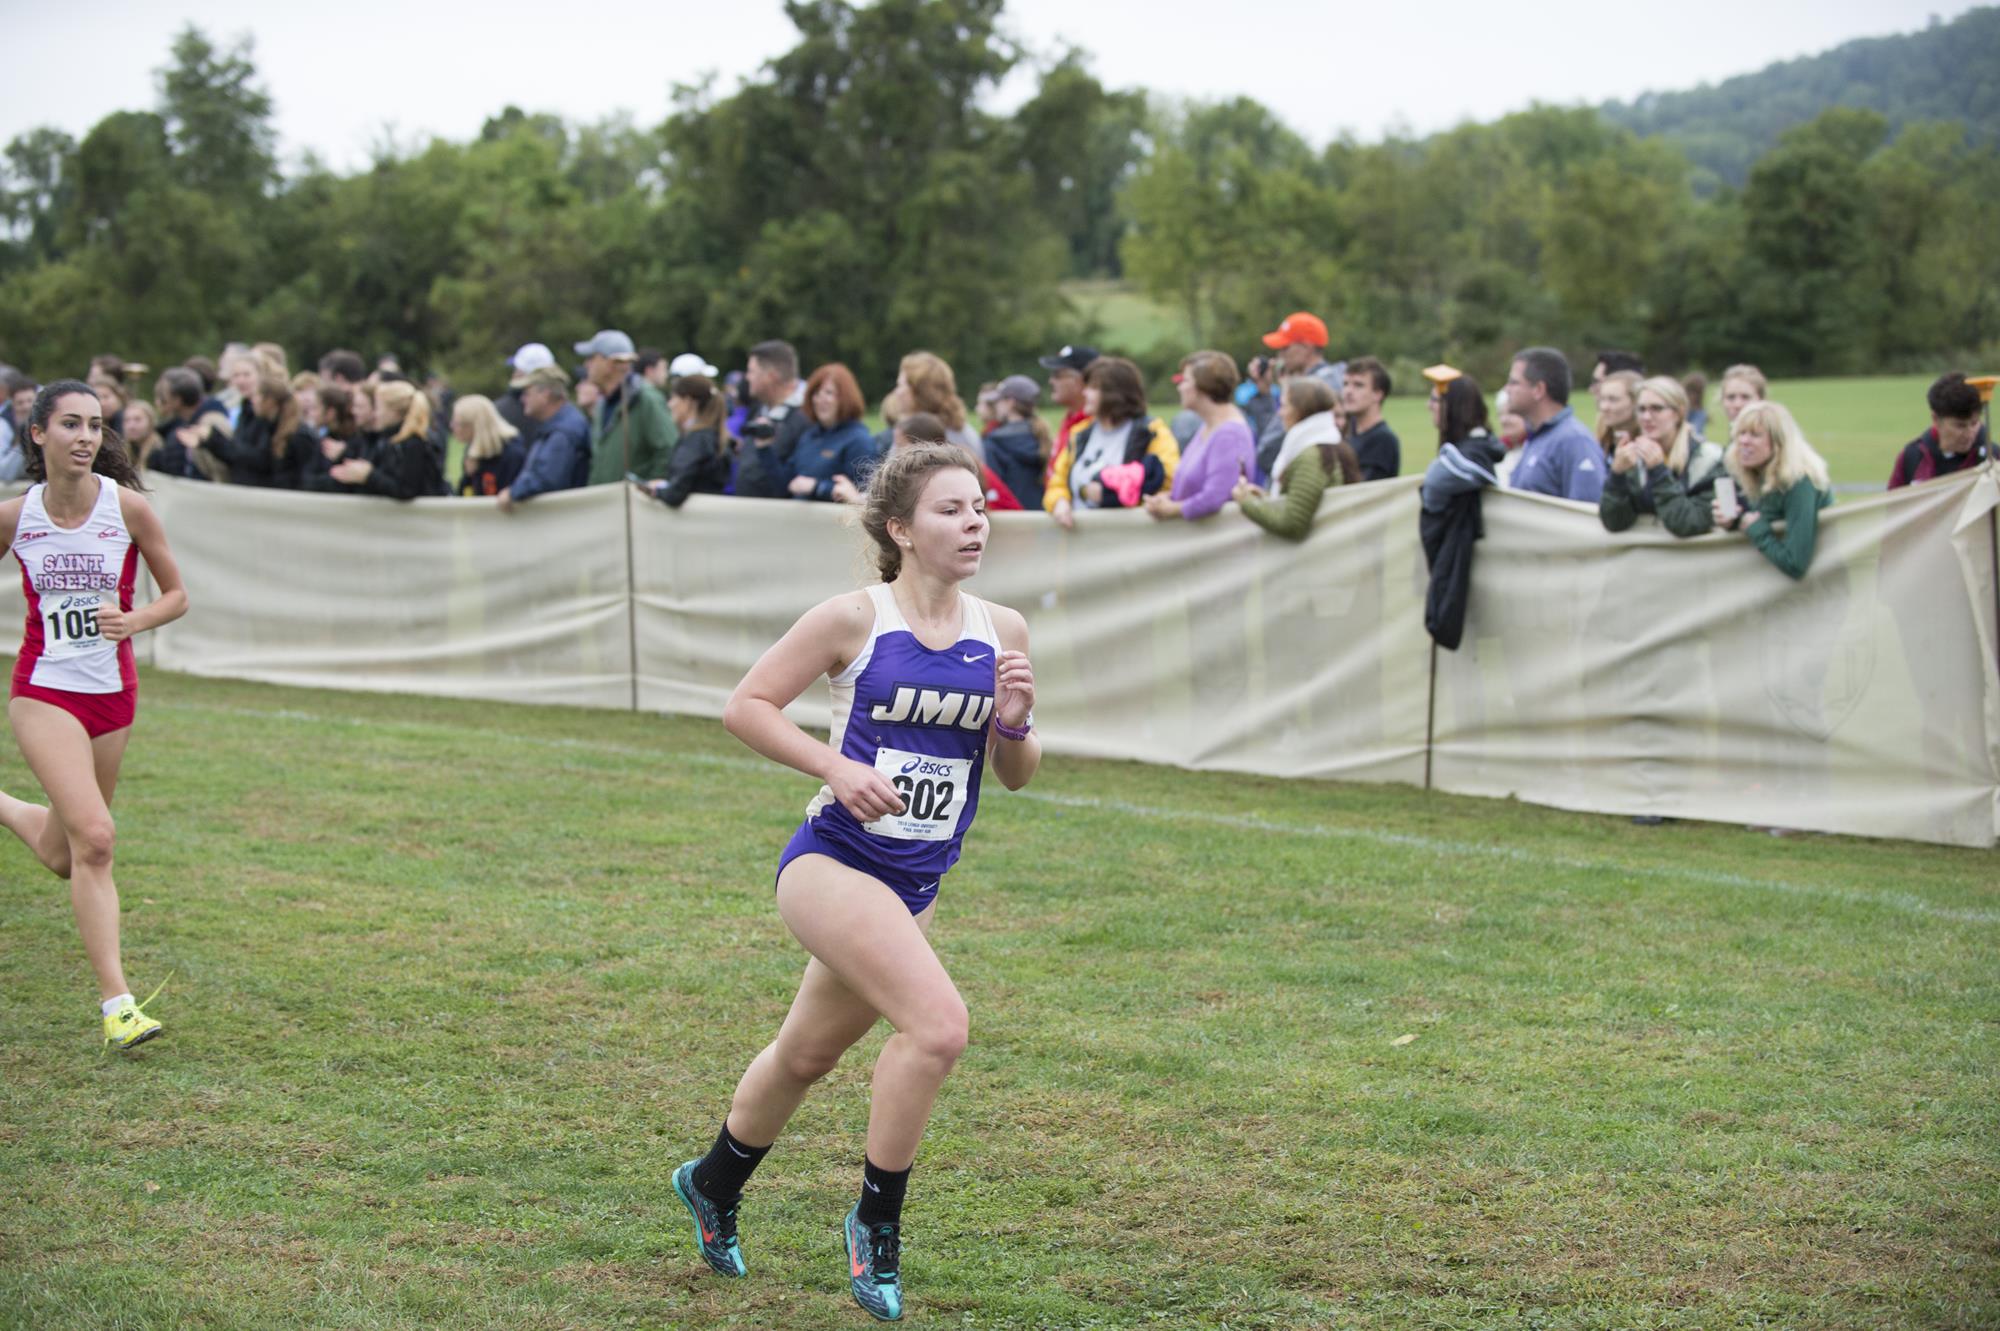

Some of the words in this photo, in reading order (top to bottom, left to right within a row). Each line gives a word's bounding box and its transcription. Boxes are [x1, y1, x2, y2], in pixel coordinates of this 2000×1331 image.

[43, 553, 104, 573] SAINT
[35, 573, 117, 591] JOSEPH'S
[48, 608, 100, 640] 105
[870, 686, 994, 731] JMU
[892, 775, 954, 820] 602
